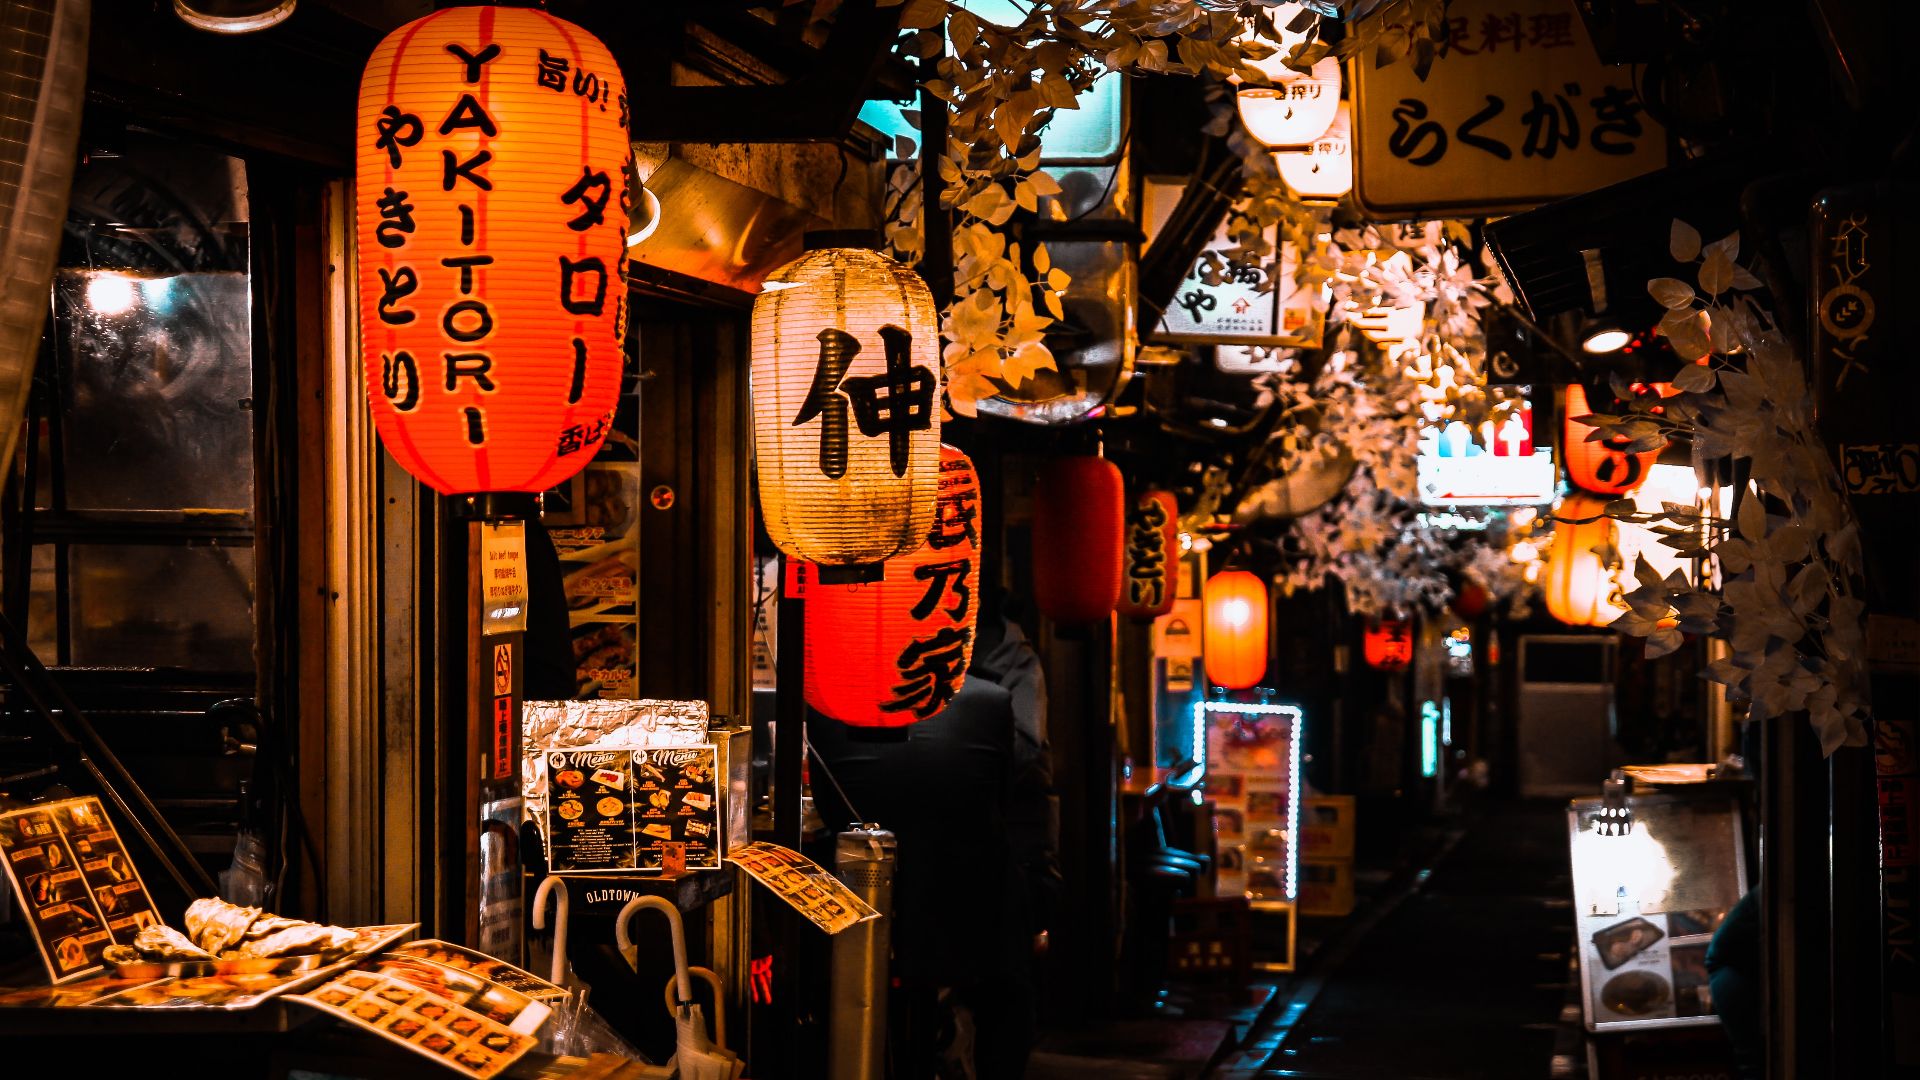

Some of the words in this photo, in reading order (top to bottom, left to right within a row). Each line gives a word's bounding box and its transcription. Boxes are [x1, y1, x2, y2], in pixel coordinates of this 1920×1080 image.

[1386, 11, 1577, 56] 足料理
[1389, 82, 1643, 167] らくがき
[375, 104, 424, 412] やきとり
[438, 43, 501, 444] YAKITORI
[560, 165, 612, 404] タロー
[792, 323, 937, 479] 伸
[570, 751, 616, 768] Menu
[652, 749, 698, 767] Menu
[586, 889, 639, 904] OLDTOWN
